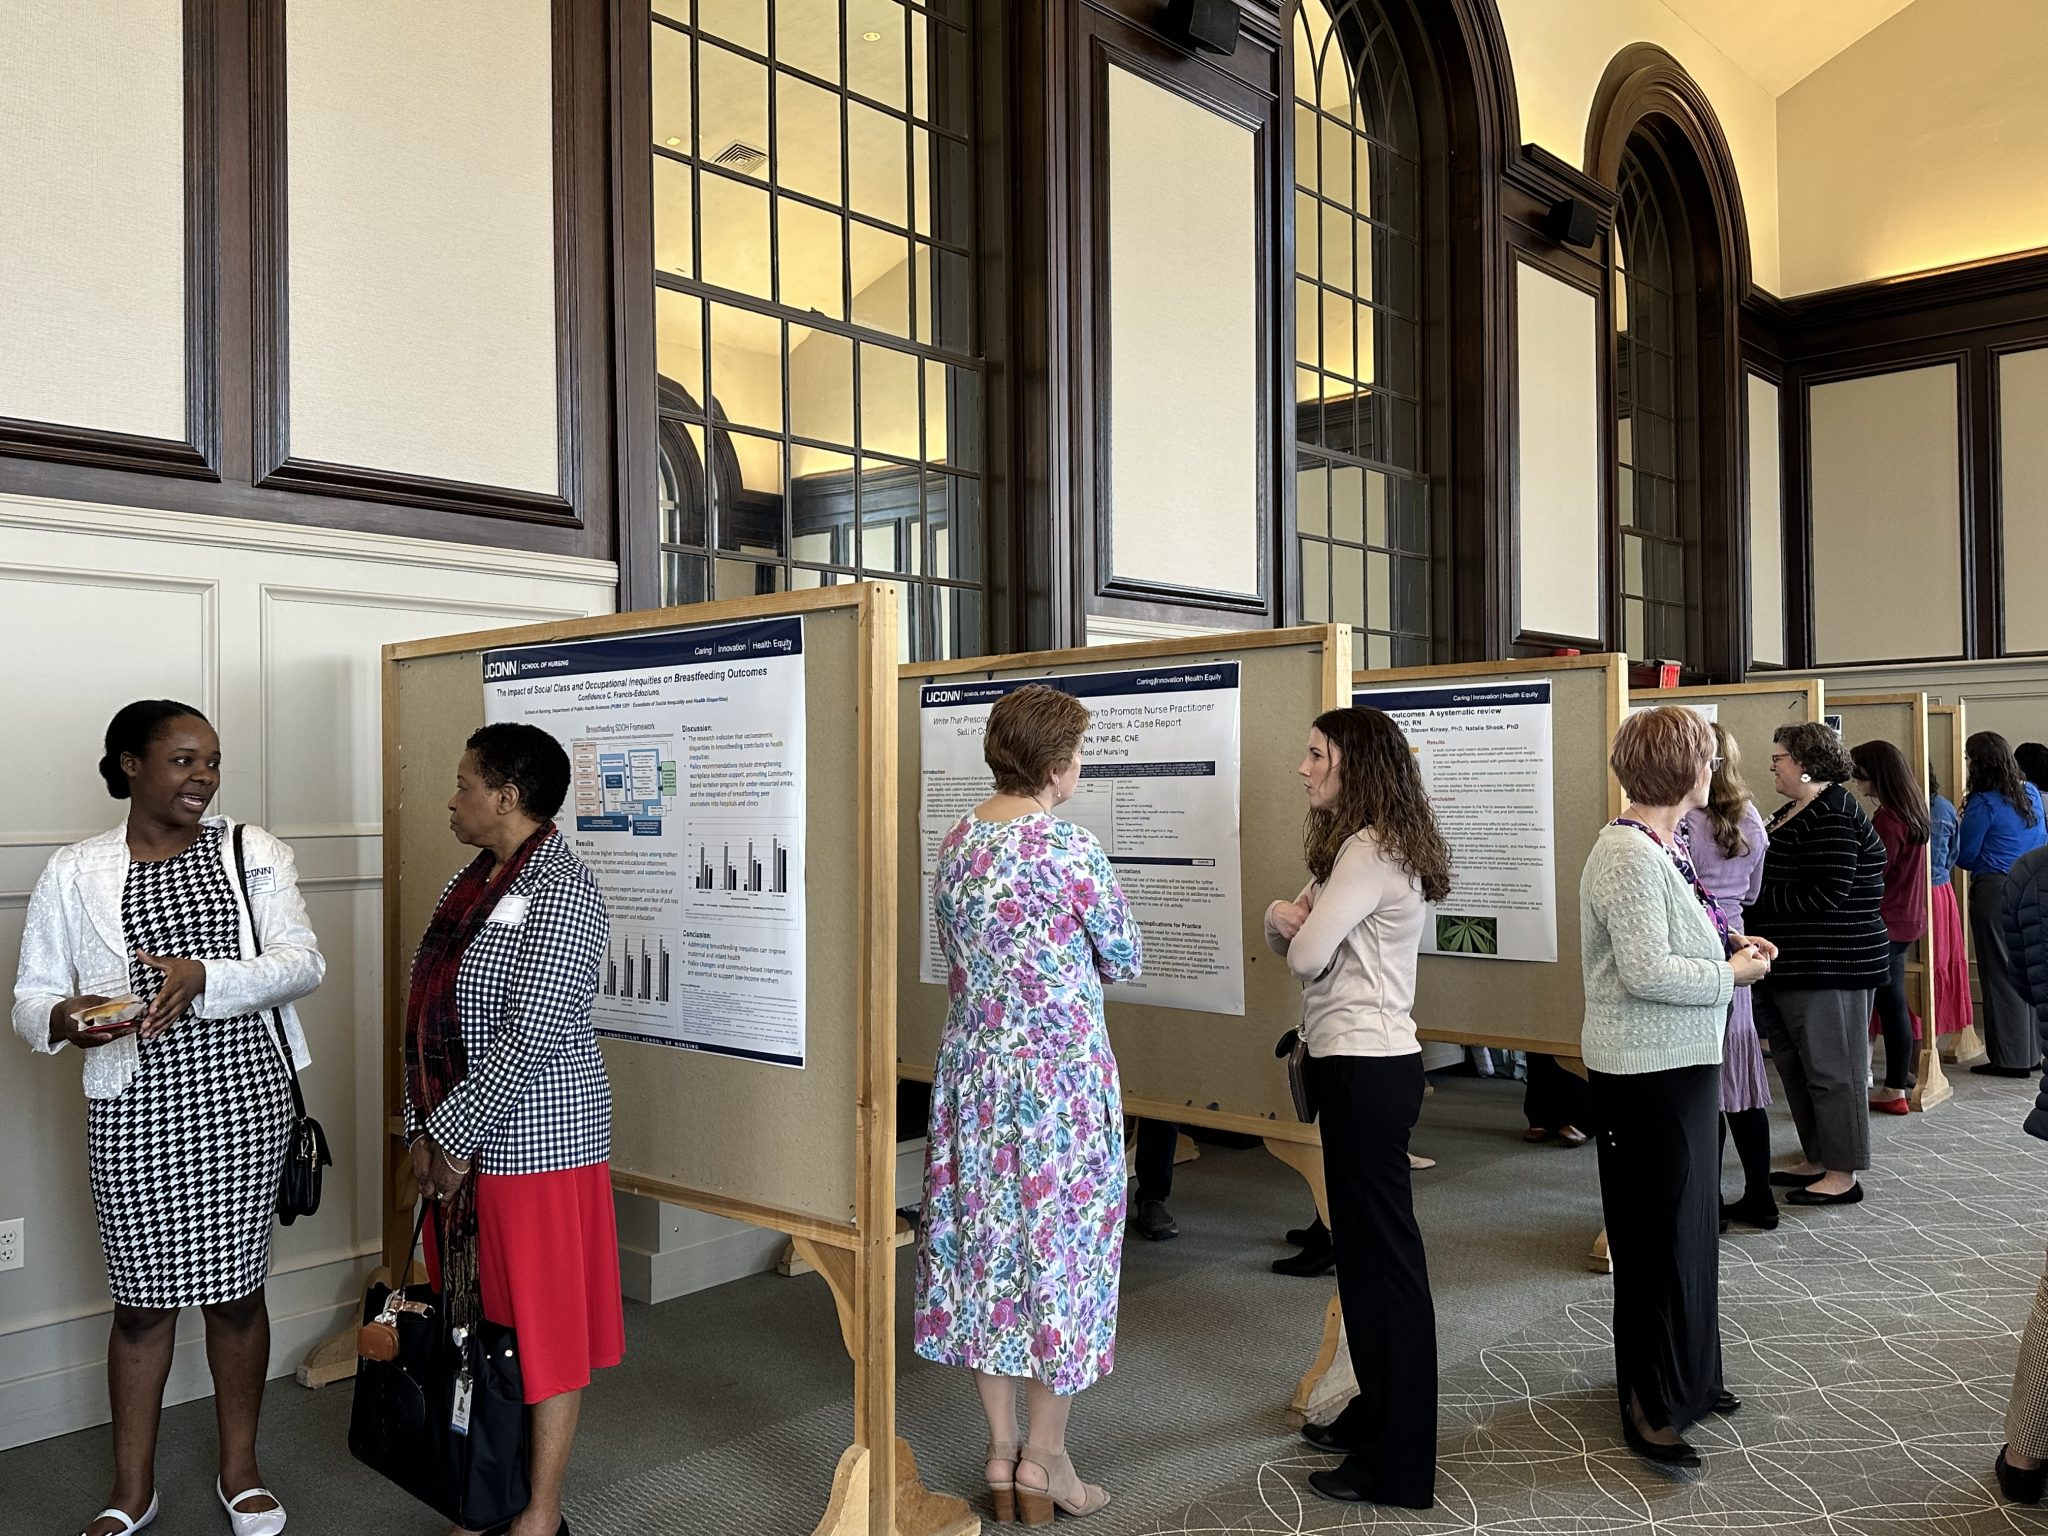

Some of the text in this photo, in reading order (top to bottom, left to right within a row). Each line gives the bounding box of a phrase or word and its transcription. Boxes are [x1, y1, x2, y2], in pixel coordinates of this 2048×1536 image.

[695, 639, 792, 656] Caring Innovation Health Equity
[485, 660, 517, 679] UCONN
[548, 660, 569, 668] NURSING
[497, 688, 506, 697] The
[508, 688, 525, 697] Impact
[527, 686, 533, 694] of
[534, 685, 552, 693] Social
[554, 684, 570, 692] Class
[585, 678, 627, 690] Occupational
[628, 675, 662, 687] Inequities
[674, 670, 725, 682] Breastfeeding
[728, 667, 767, 678] Outcomes
[1136, 674, 1221, 686] Caring Innovation Health Equity
[578, 693, 605, 701] Confidence
[926, 690, 960, 703] UCONN
[1473, 693, 1500, 701] Innovation
[1110, 707, 1142, 716] Promote
[1144, 706, 1168, 714] Nurse
[1170, 704, 1215, 712] Practitioner
[1437, 709, 1475, 718] systematic
[586, 723, 655, 734] Breastfeeding SDOH Framework
[682, 724, 712, 732] Discussion:
[1098, 721, 1125, 730] Orders:
[1134, 720, 1153, 728] Case
[1155, 718, 1181, 727] Report
[957, 728, 970, 736] Skill
[1097, 735, 1123, 743] FNP-BC,
[1104, 748, 1128, 756] Nursing
[245, 867, 271, 878] CONN
[683, 930, 711, 939] Conclusion:
[688, 942, 709, 950] Addressing
[710, 943, 737, 952] breastfeeding
[700, 961, 715, 969] changes
[726, 963, 762, 972] community-based
[764, 966, 792, 976] interventions
[761, 976, 778, 984] mothers
